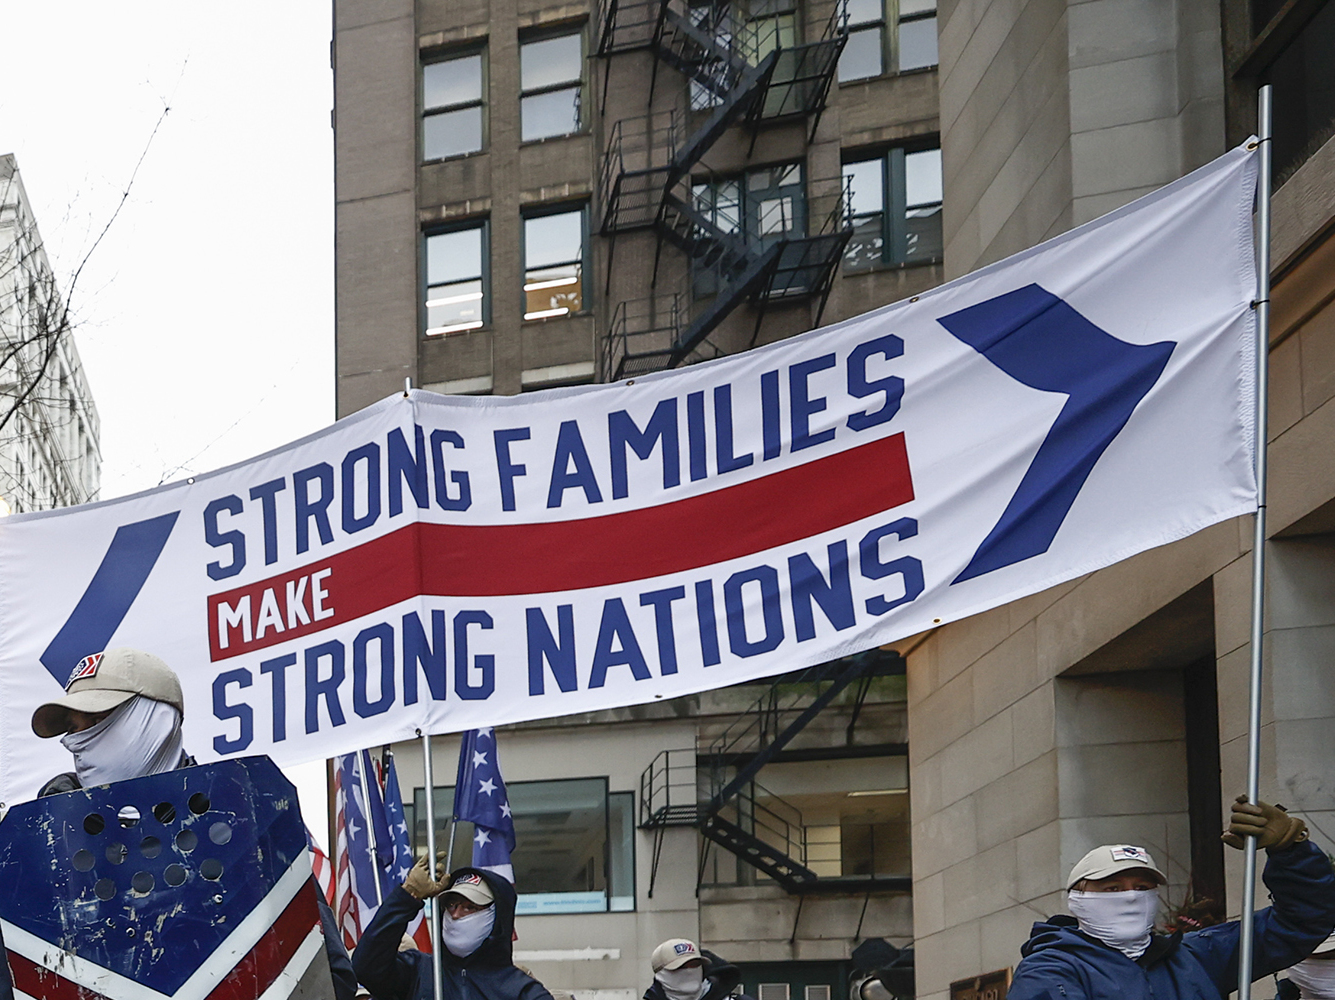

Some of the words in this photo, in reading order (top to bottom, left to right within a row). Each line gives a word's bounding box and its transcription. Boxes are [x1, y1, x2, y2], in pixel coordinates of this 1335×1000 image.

[203, 424, 471, 580] STRONG
[494, 334, 905, 512] FAMILIES
[212, 609, 494, 756] STRONG
[526, 516, 925, 697] NATIONS
[217, 567, 335, 650] MAKE
